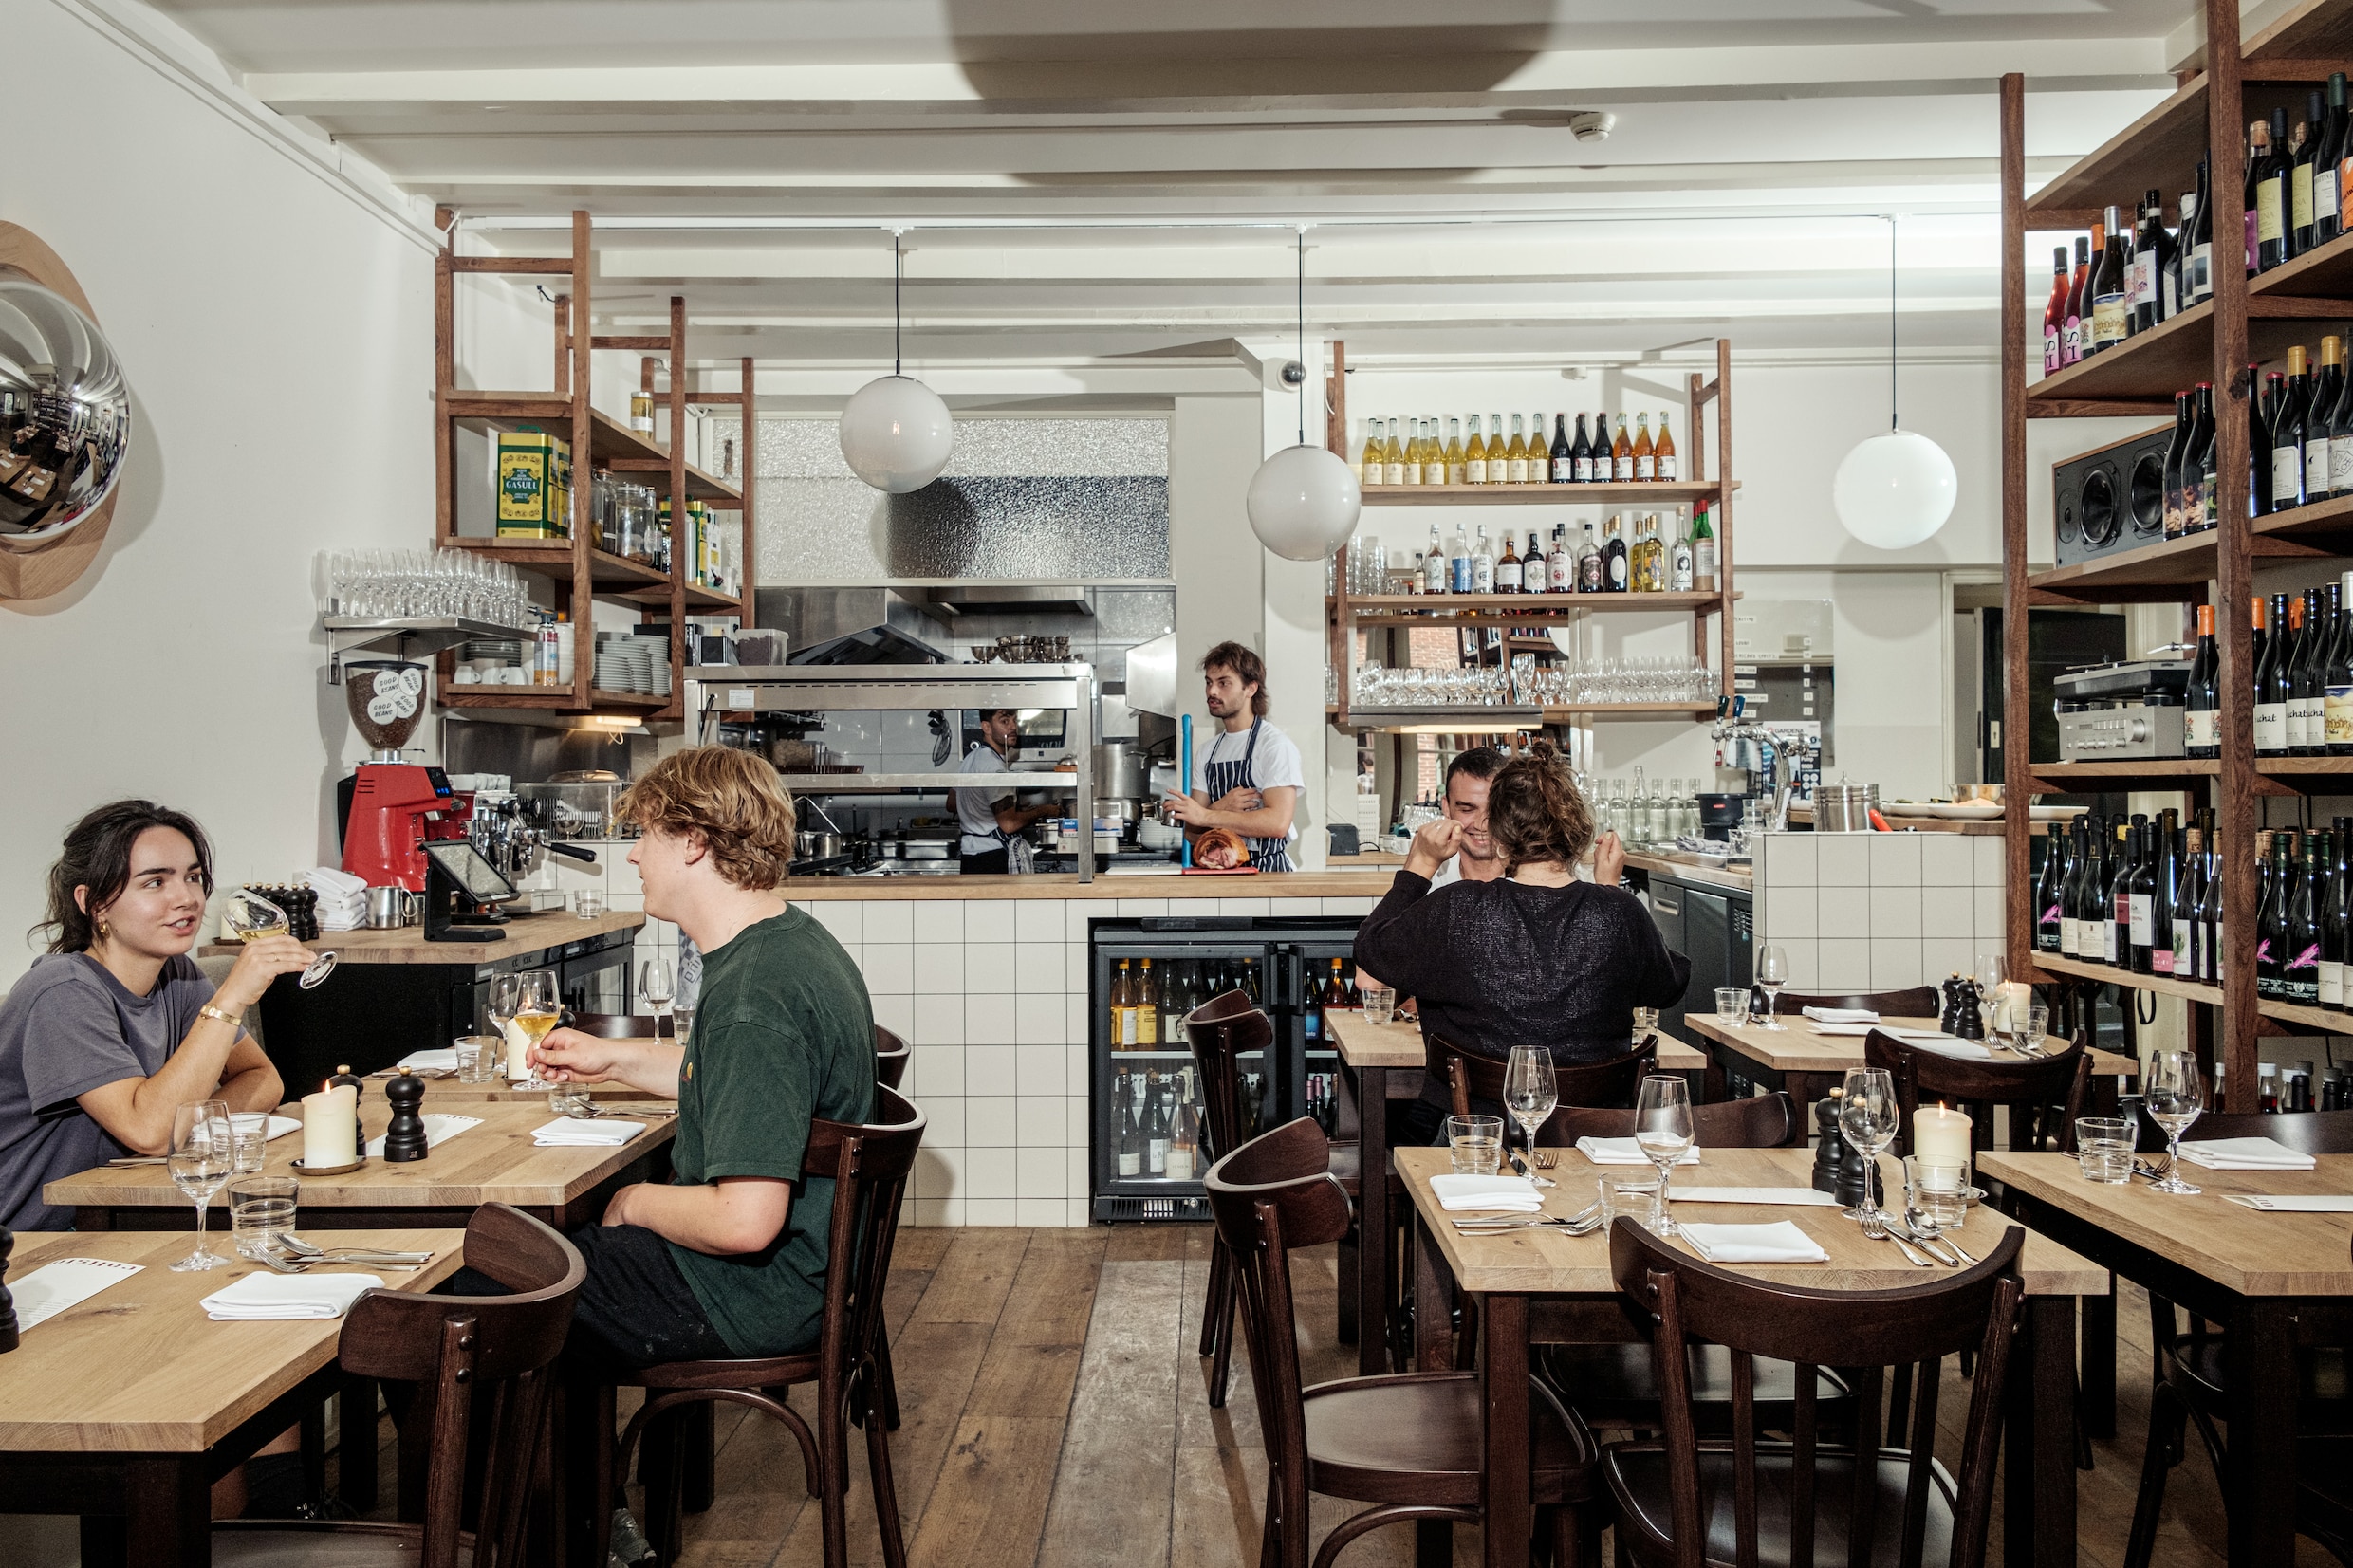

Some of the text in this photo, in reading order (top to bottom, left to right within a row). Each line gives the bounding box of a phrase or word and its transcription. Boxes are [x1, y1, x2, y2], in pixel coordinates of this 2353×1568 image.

[506, 481, 537, 489] GASULL
[380, 676, 397, 686] GOOD
[404, 676, 415, 691] BEANS
[410, 673, 419, 688] GOOD
[380, 683, 398, 693] BEANS
[395, 700, 410, 713] BEANS
[400, 695, 415, 708] GOOD
